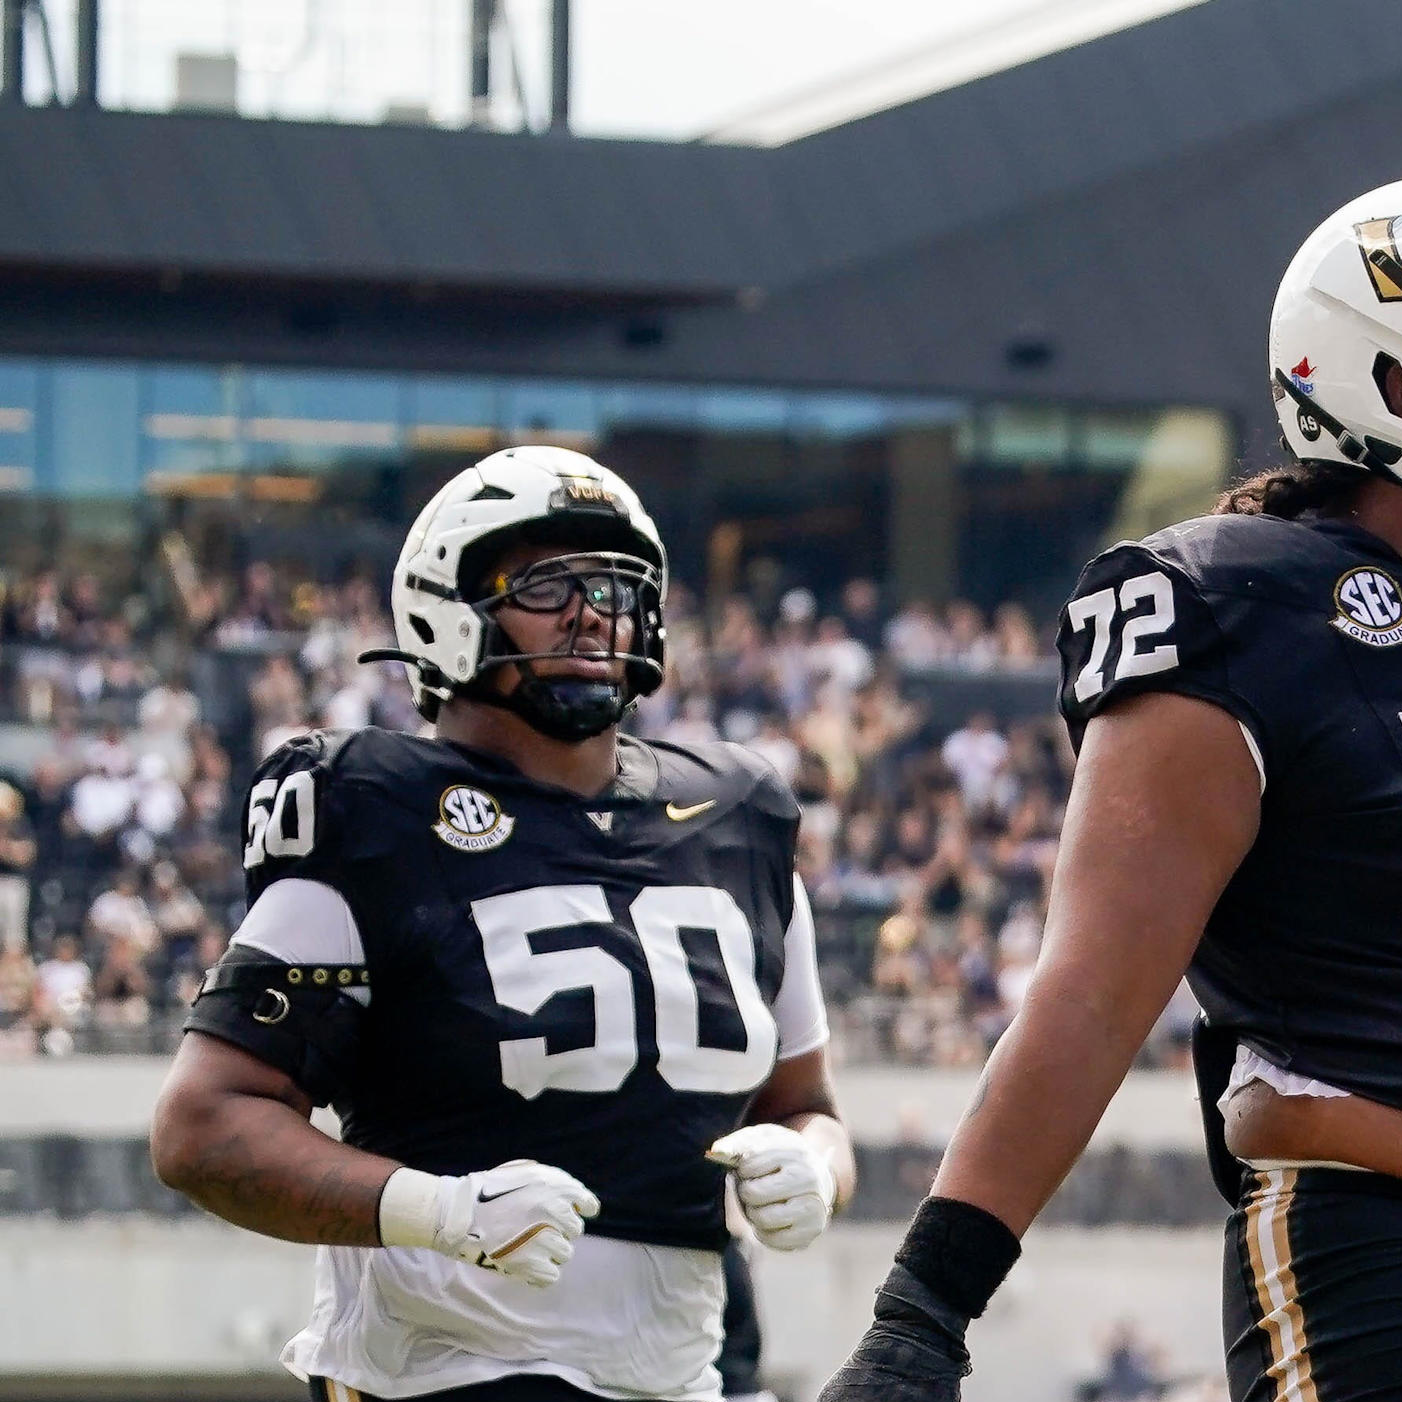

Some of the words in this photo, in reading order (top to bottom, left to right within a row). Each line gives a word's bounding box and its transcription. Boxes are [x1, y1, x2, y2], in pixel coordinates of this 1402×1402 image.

[1300, 415, 1318, 432] AS
[1341, 571, 1401, 627] SEC
[1067, 570, 1180, 703] 72
[242, 769, 316, 870] 50
[444, 787, 496, 834] SEC
[445, 826, 507, 849] GRADUATE
[469, 884, 779, 1100] 50
